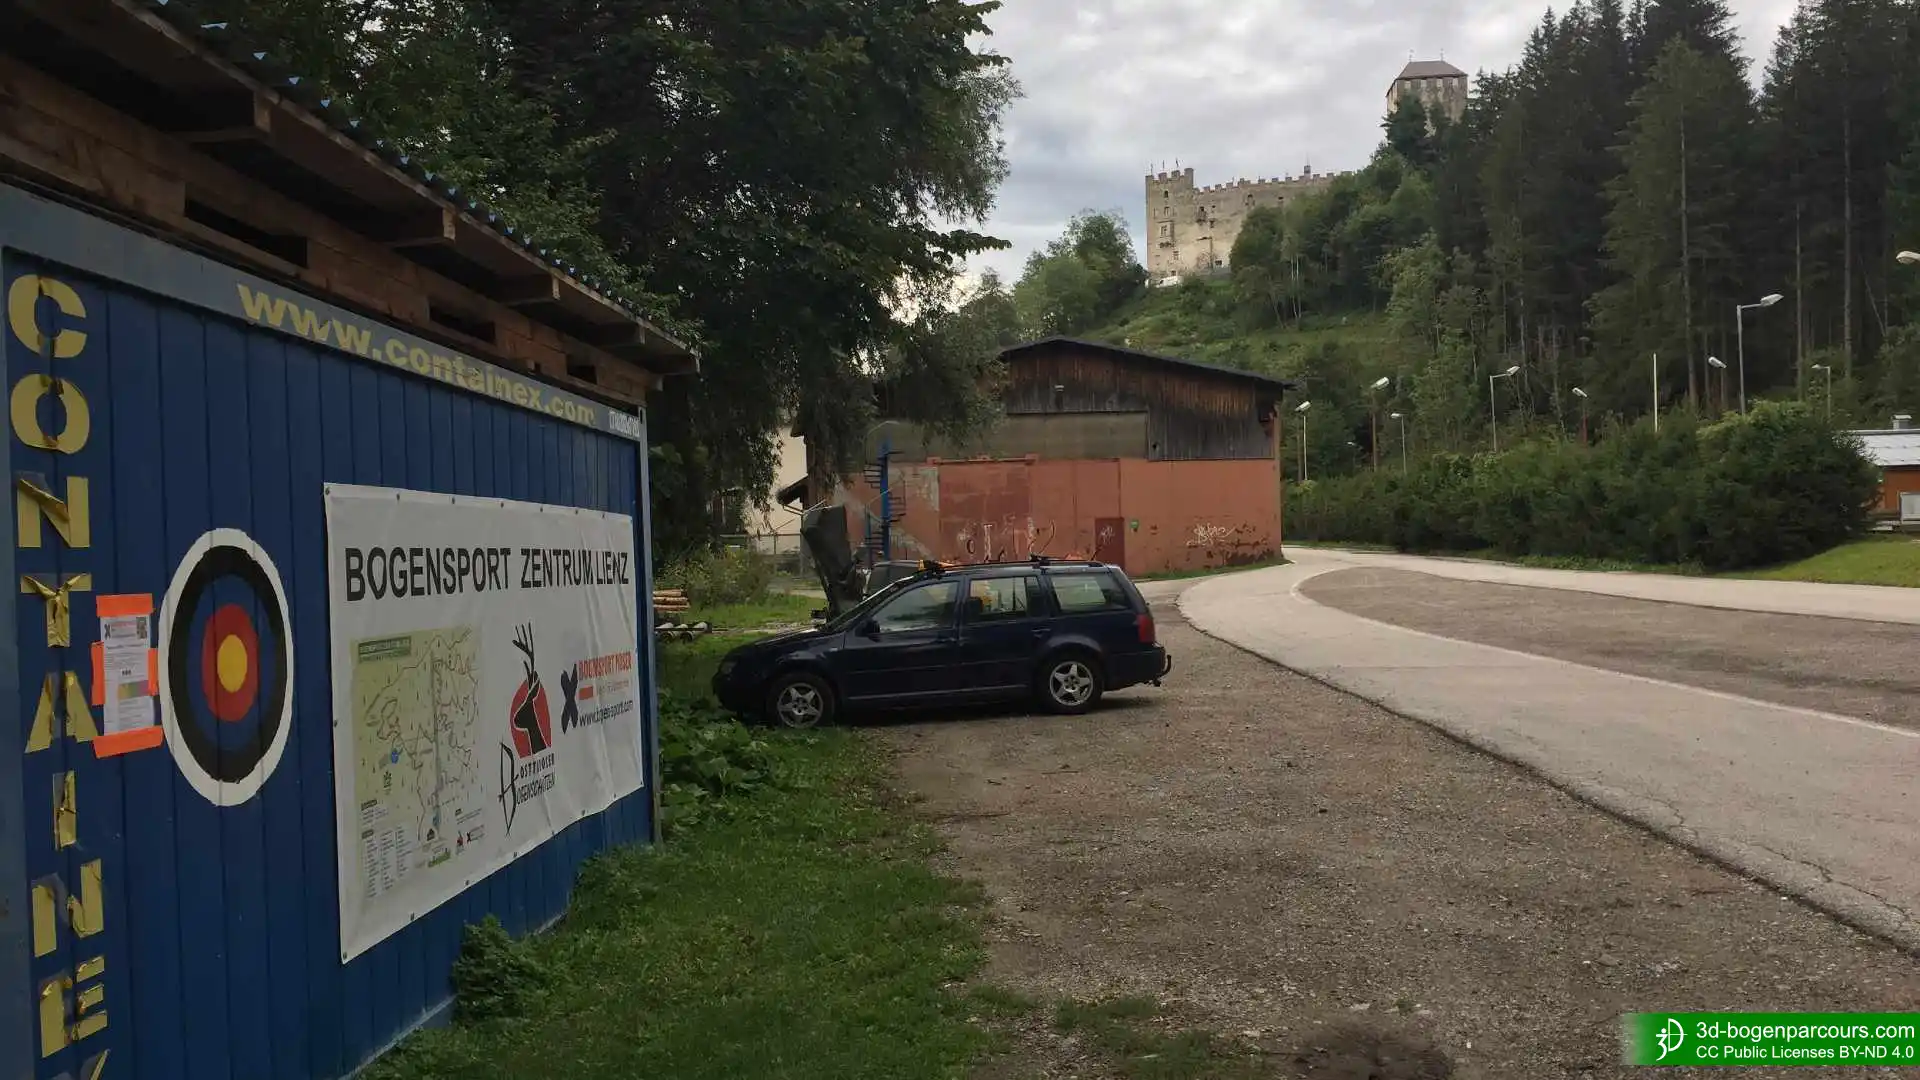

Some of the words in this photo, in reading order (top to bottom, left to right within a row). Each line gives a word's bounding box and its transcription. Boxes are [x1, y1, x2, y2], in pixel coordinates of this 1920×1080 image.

[237, 283, 598, 428] www.containex.com
[345, 546, 511, 601] BOGENSPORT
[520, 548, 594, 588] ZENTRUM
[595, 551, 629, 585] LIENZ
[8, 274, 110, 1080] CONTAINE
